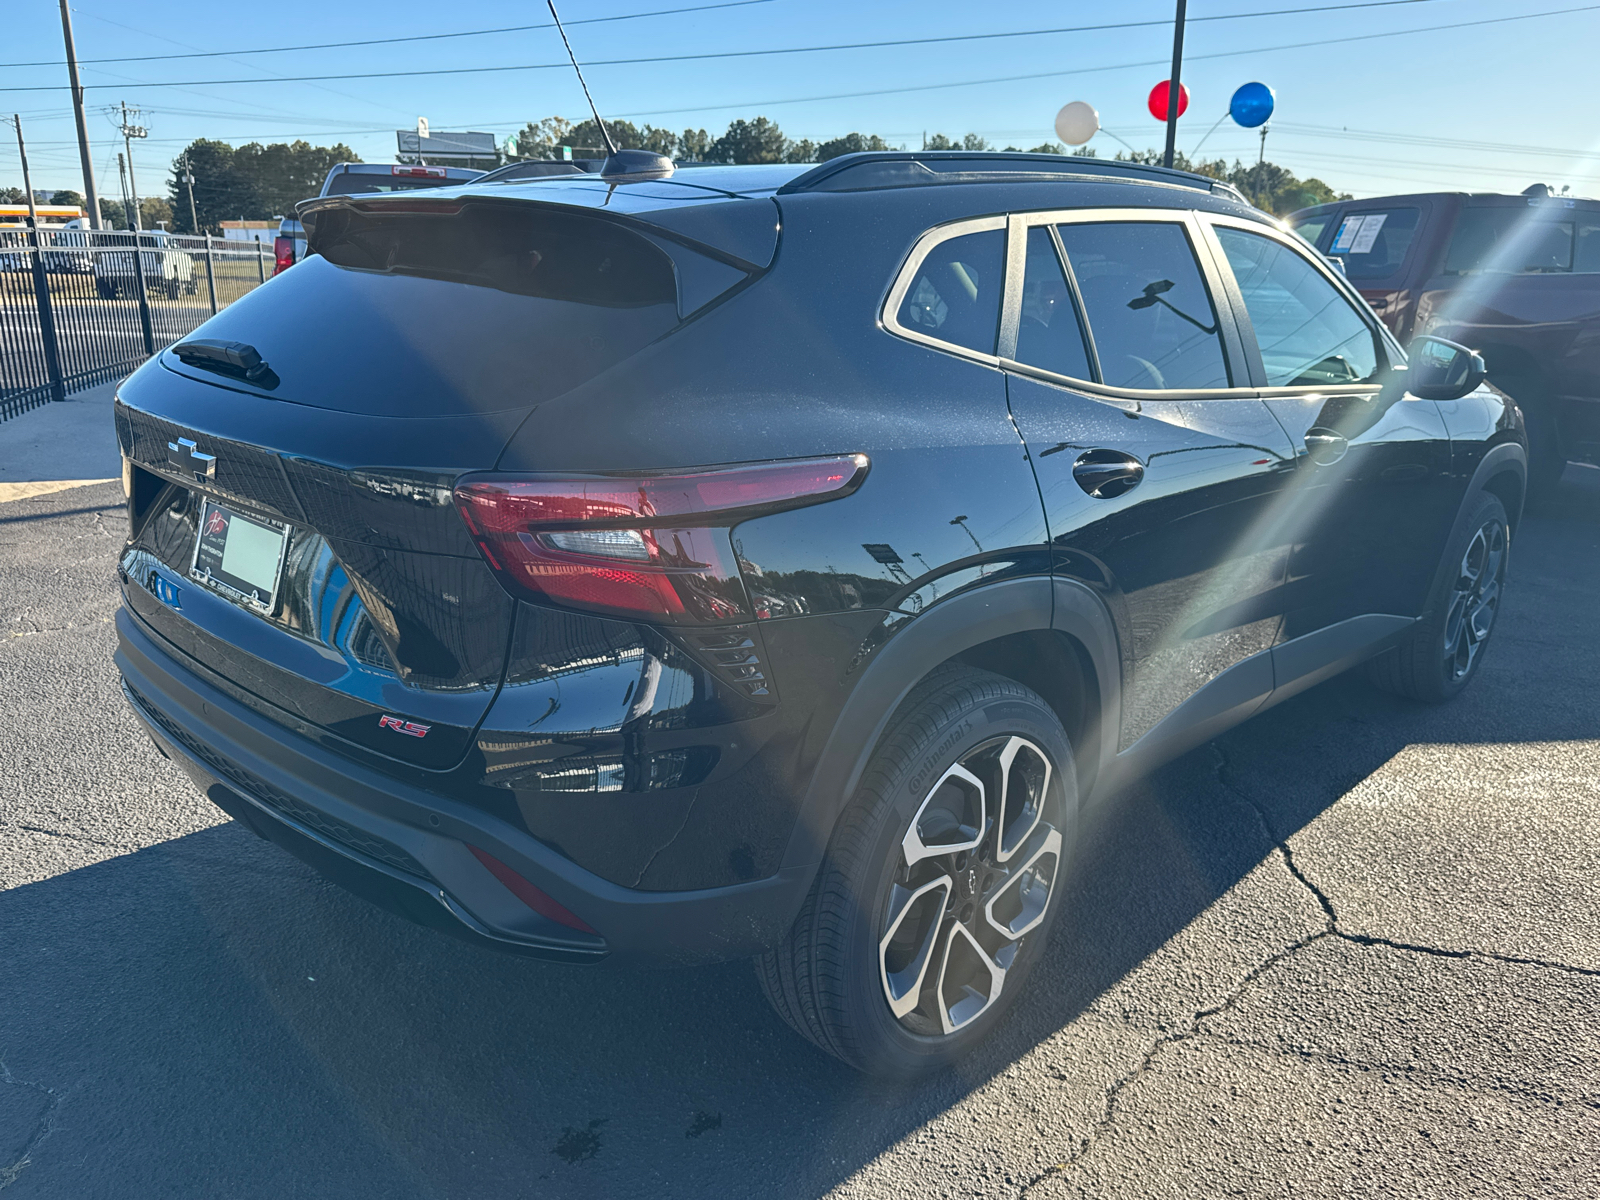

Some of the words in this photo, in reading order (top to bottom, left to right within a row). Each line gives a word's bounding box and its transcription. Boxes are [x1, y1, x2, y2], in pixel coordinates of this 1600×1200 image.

[216, 583, 241, 600] CHEVROLET
[378, 714, 431, 738] RS
[908, 726, 966, 797] Continental
